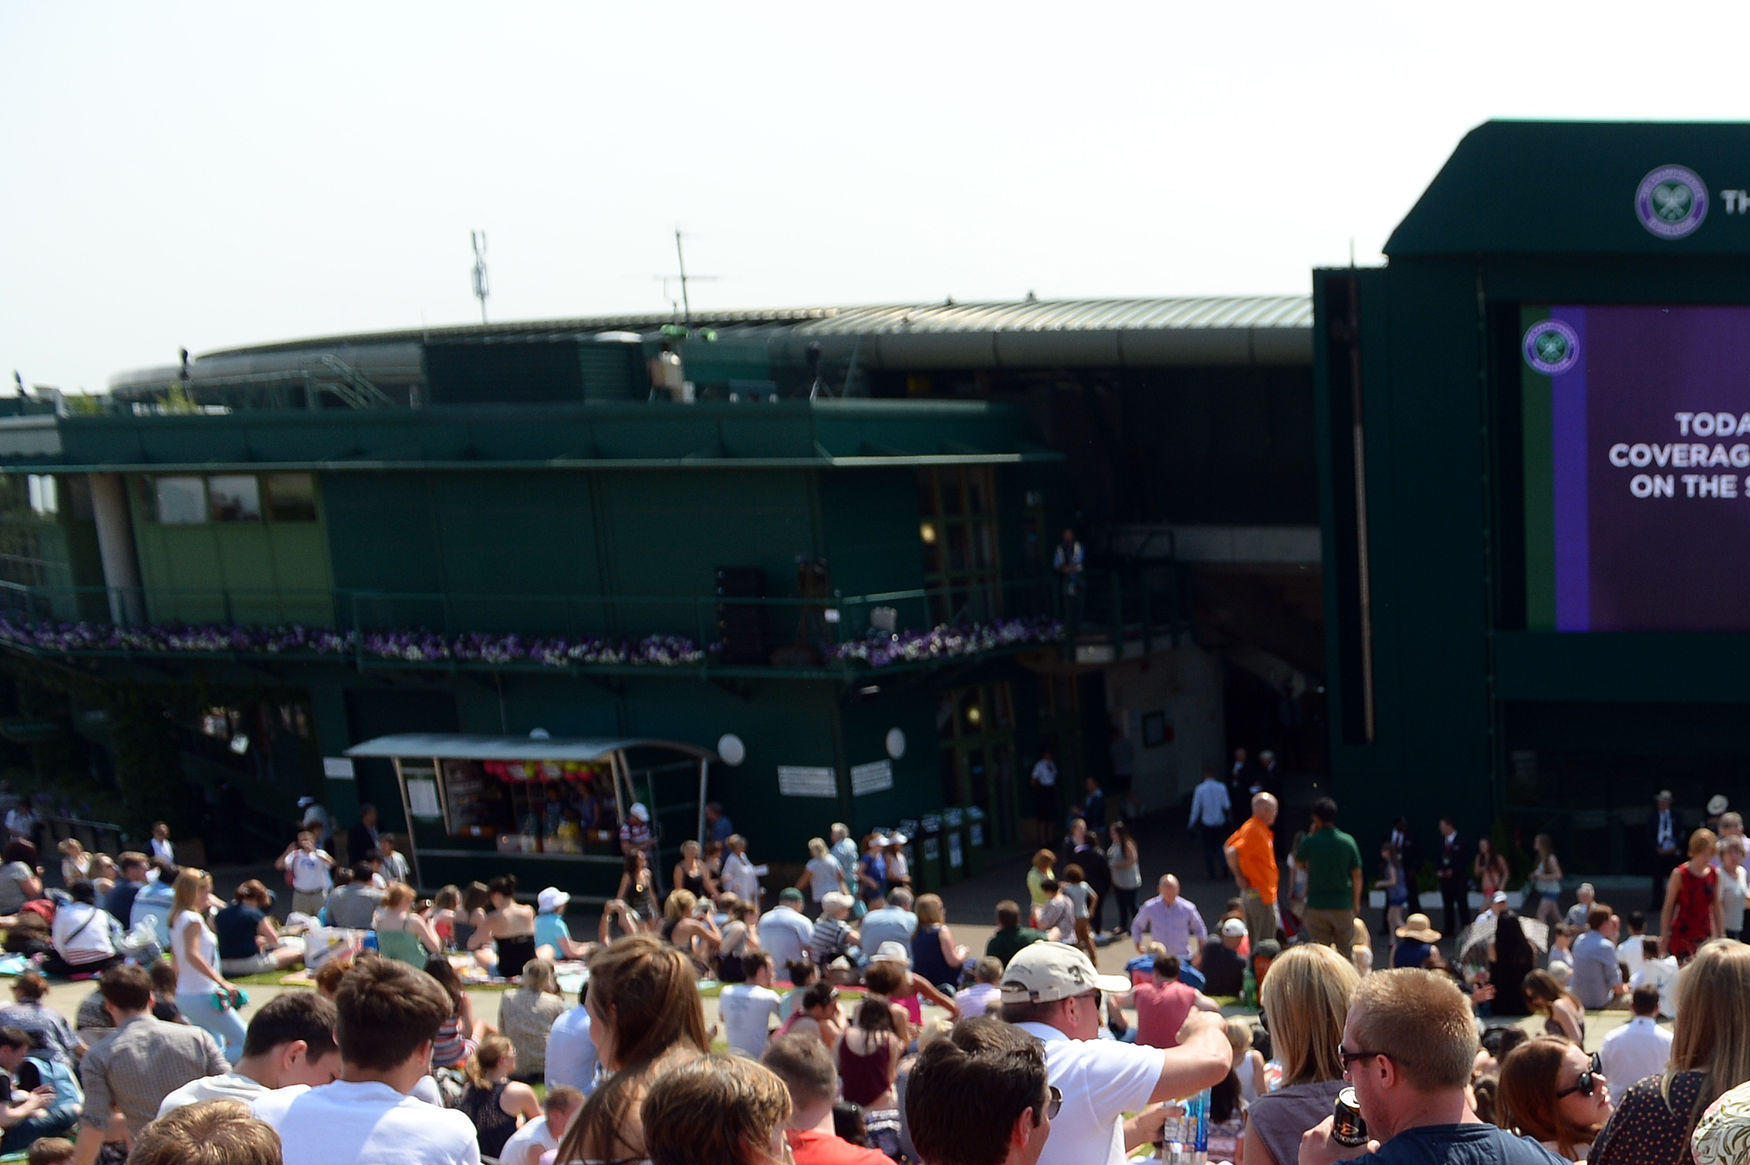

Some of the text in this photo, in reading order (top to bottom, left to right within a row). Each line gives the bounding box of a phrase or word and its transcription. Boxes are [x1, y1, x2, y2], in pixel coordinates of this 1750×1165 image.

[1629, 474, 1675, 498] ON
[1681, 474, 1738, 498] THE
[1068, 965, 1084, 985] 3
